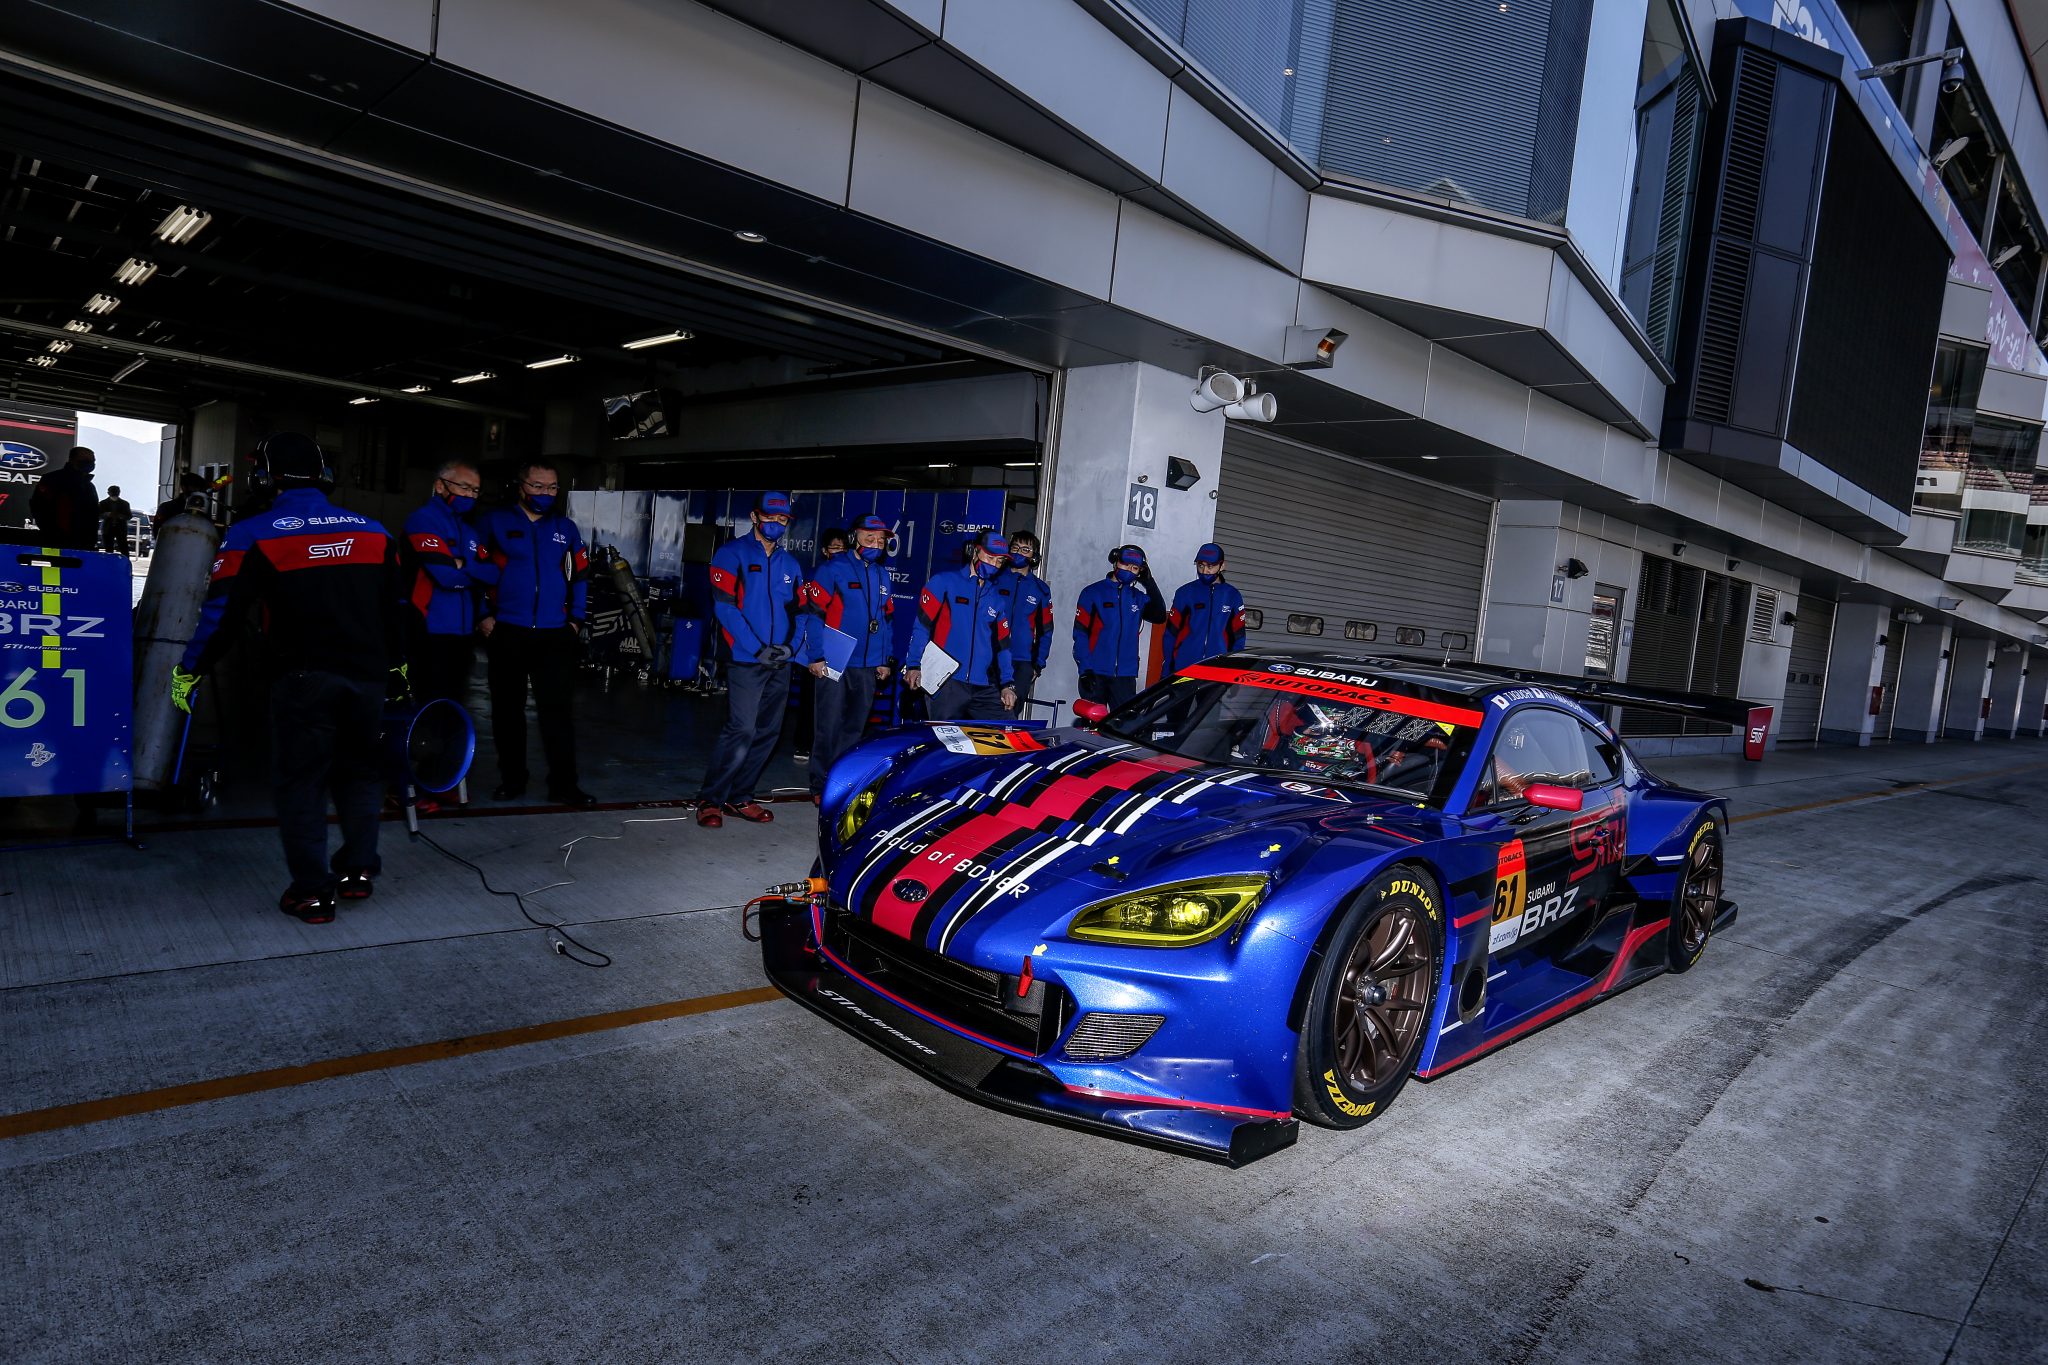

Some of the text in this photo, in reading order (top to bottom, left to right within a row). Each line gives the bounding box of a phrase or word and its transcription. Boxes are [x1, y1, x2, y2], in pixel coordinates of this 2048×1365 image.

[307, 516, 367, 525] SUBARU
[1132, 491, 1155, 523] 18
[887, 519, 915, 558] 61
[27, 585, 79, 594] SUBARU
[1553, 578, 1564, 599] 17
[1261, 676, 1397, 705] AUTOBACS
[1294, 667, 1379, 687] SUBARU
[0, 667, 86, 728] 61
[870, 829, 1030, 898] Poud of BOXER
[1497, 851, 1522, 865] TOBACS
[1389, 880, 1437, 920] DUNLOP
[1492, 874, 1519, 922] 61
[1527, 881, 1556, 903] SUBARU
[1519, 886, 1580, 937] BRZ
[1323, 1068, 1376, 1117] DIREZZA
